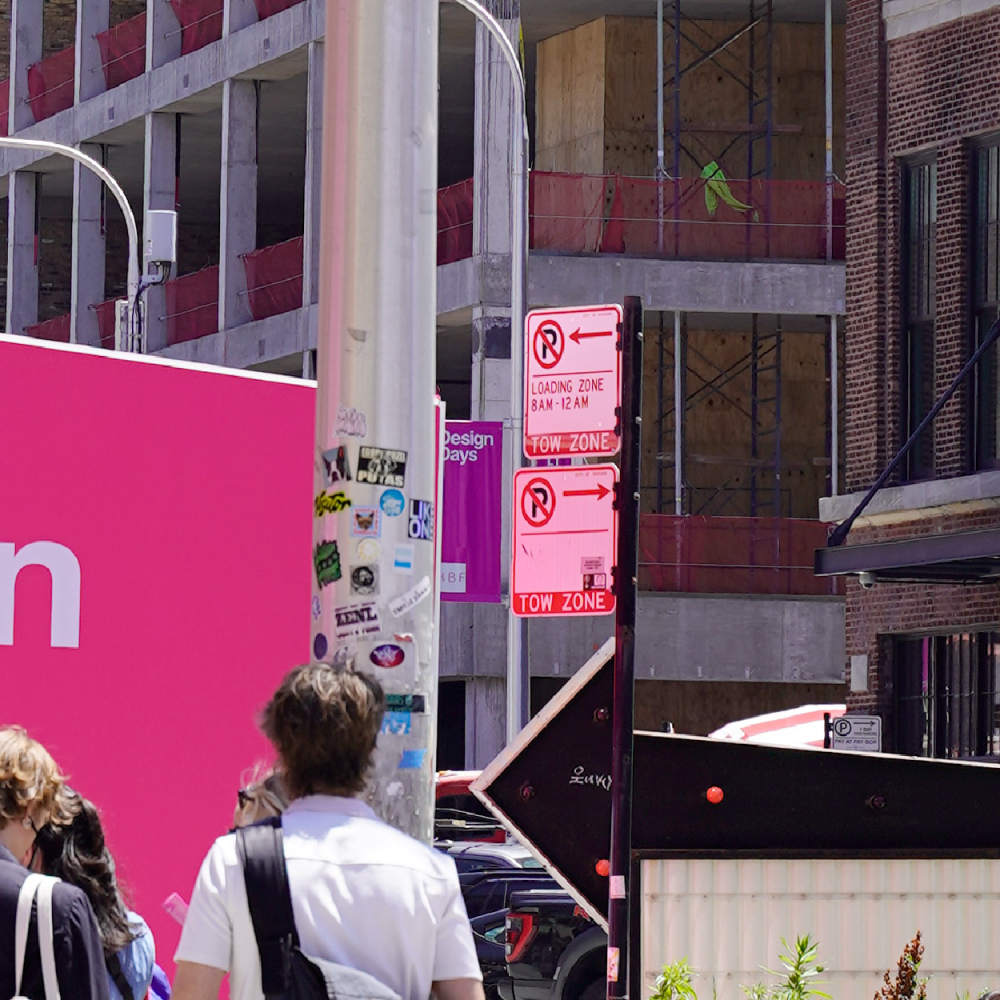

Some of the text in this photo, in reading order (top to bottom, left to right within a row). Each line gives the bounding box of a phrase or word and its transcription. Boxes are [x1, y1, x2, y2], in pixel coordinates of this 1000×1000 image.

[531, 377, 604, 395] LOADING ZONE
[444, 430, 494, 450] Design
[531, 432, 610, 454] TOW ZONE
[444, 447, 478, 466] Days
[519, 592, 606, 613] TOW ZONE
